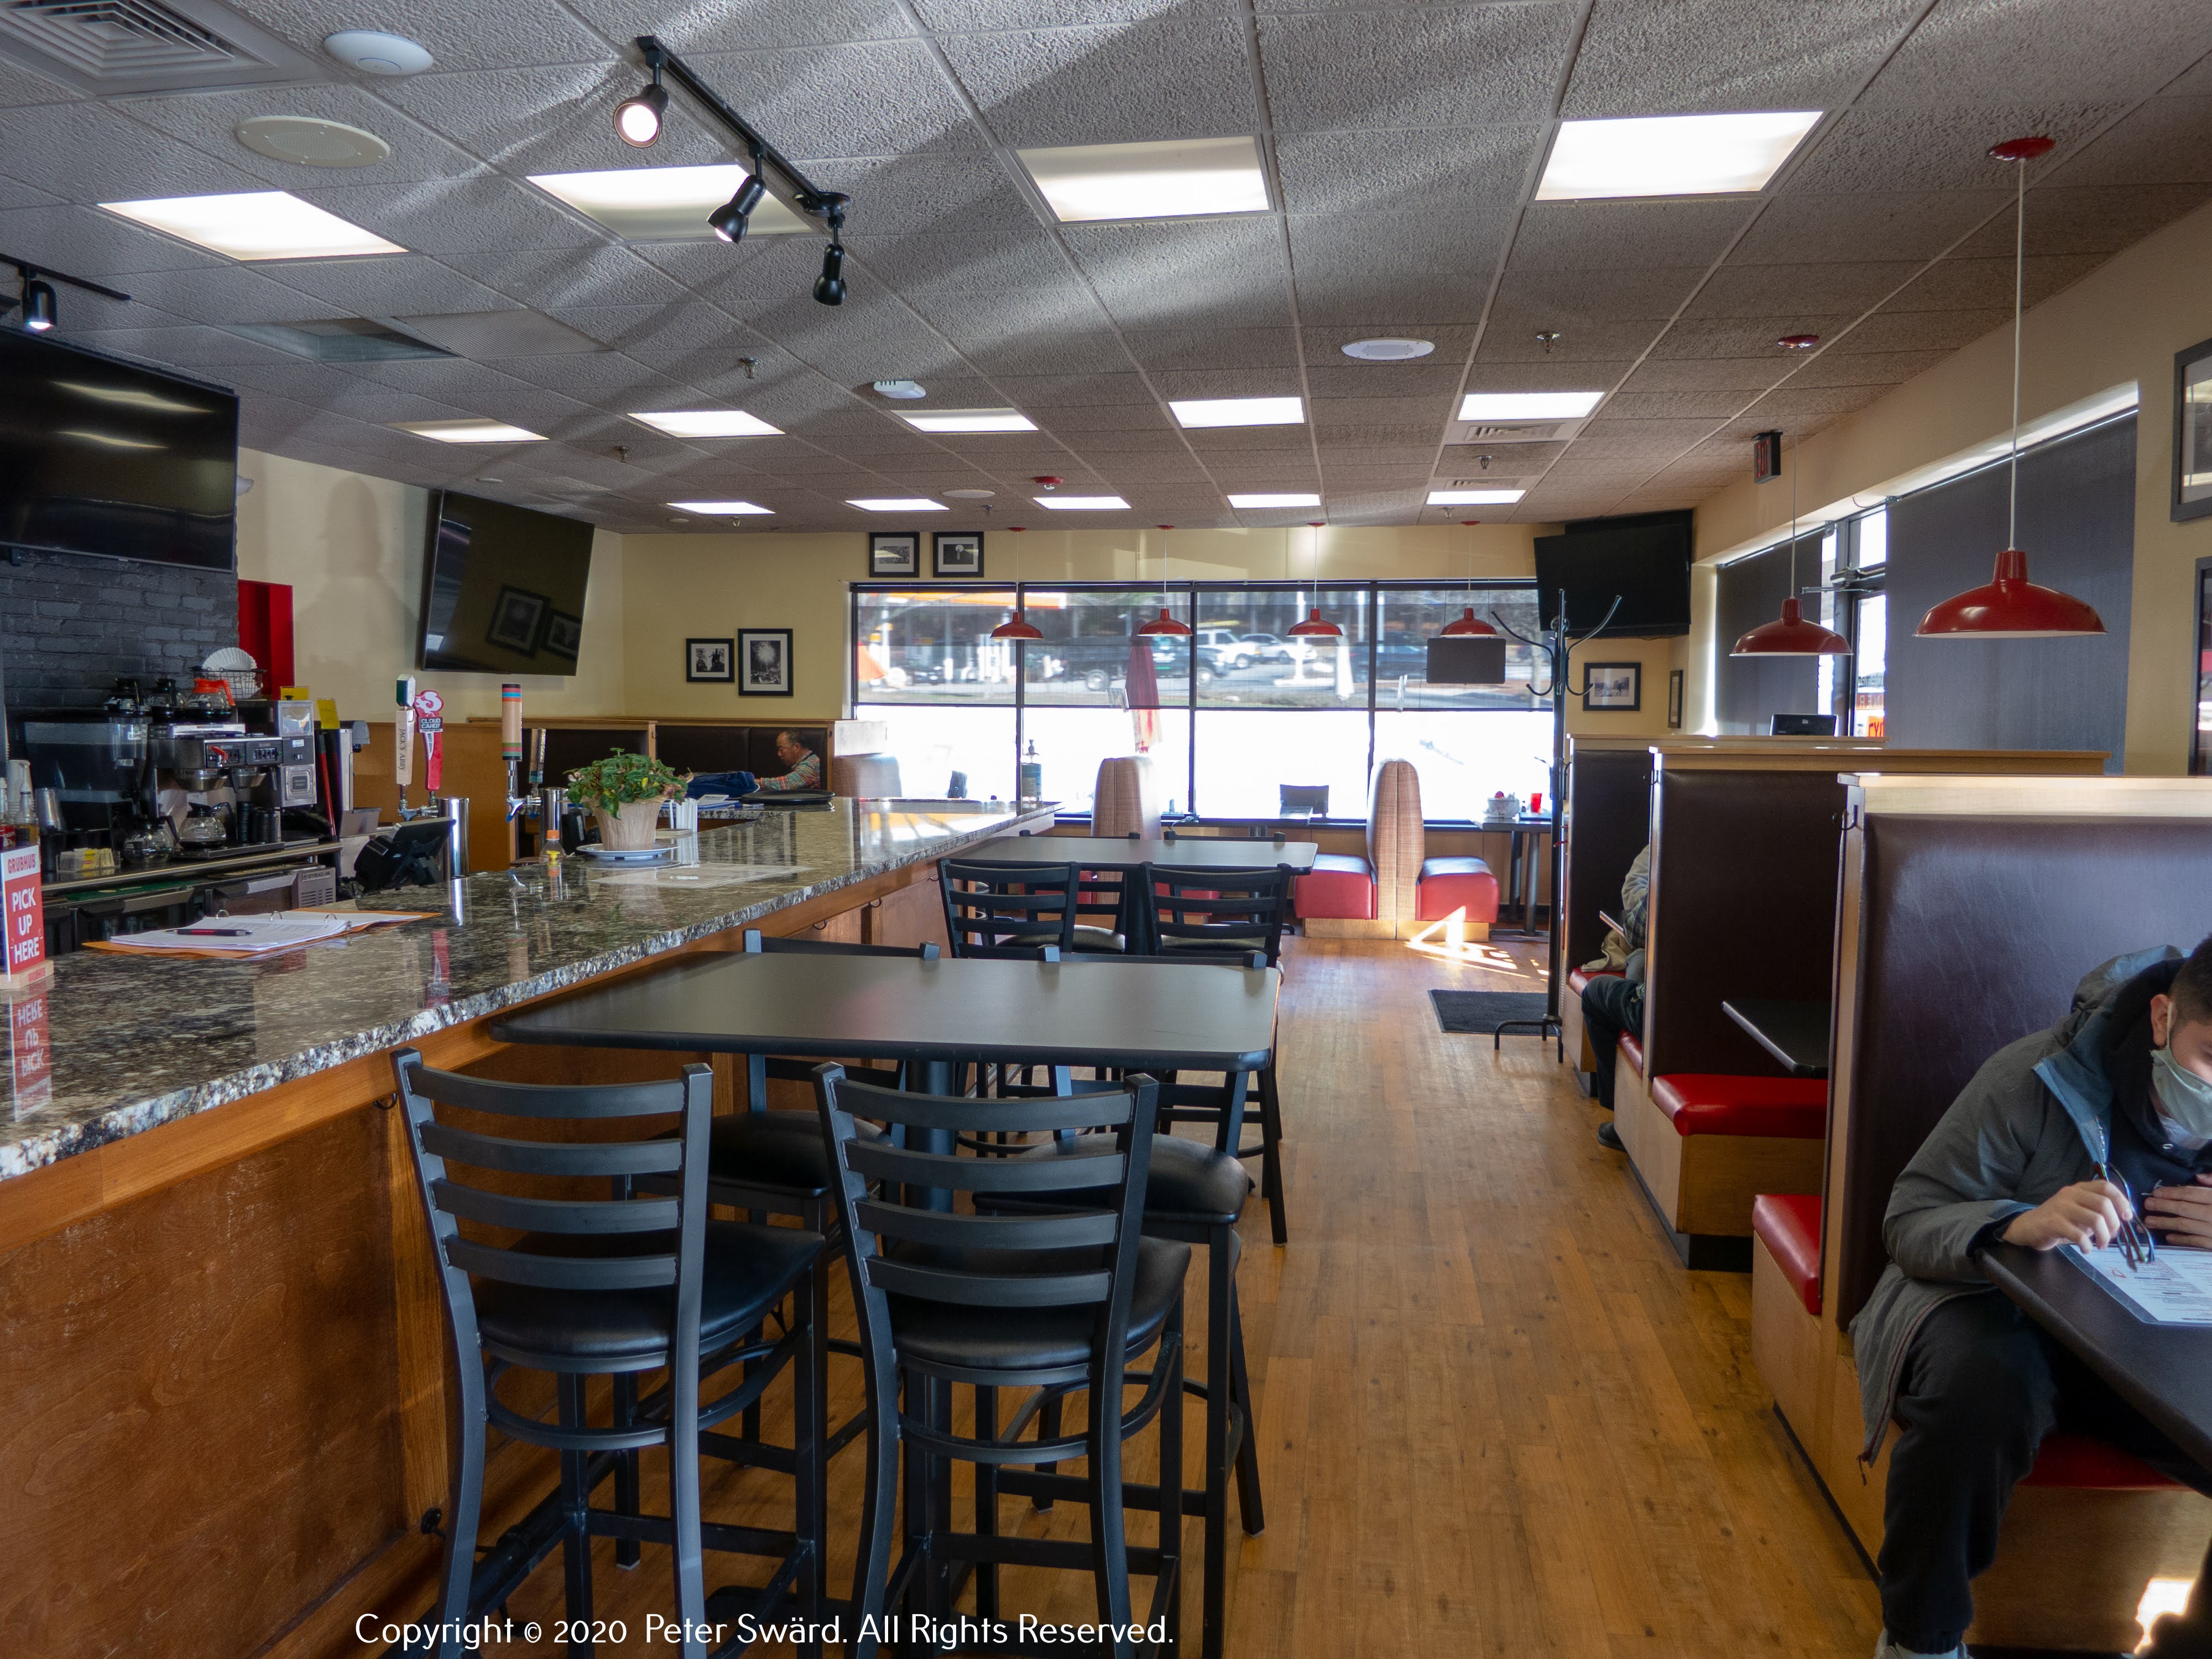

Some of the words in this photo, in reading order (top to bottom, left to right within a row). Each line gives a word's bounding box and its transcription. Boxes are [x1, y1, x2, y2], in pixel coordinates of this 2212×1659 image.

[8, 853, 36, 874] GRUBHUB
[12, 887, 36, 912] PICK
[18, 914, 32, 936] UP
[14, 937, 40, 964] HERE
